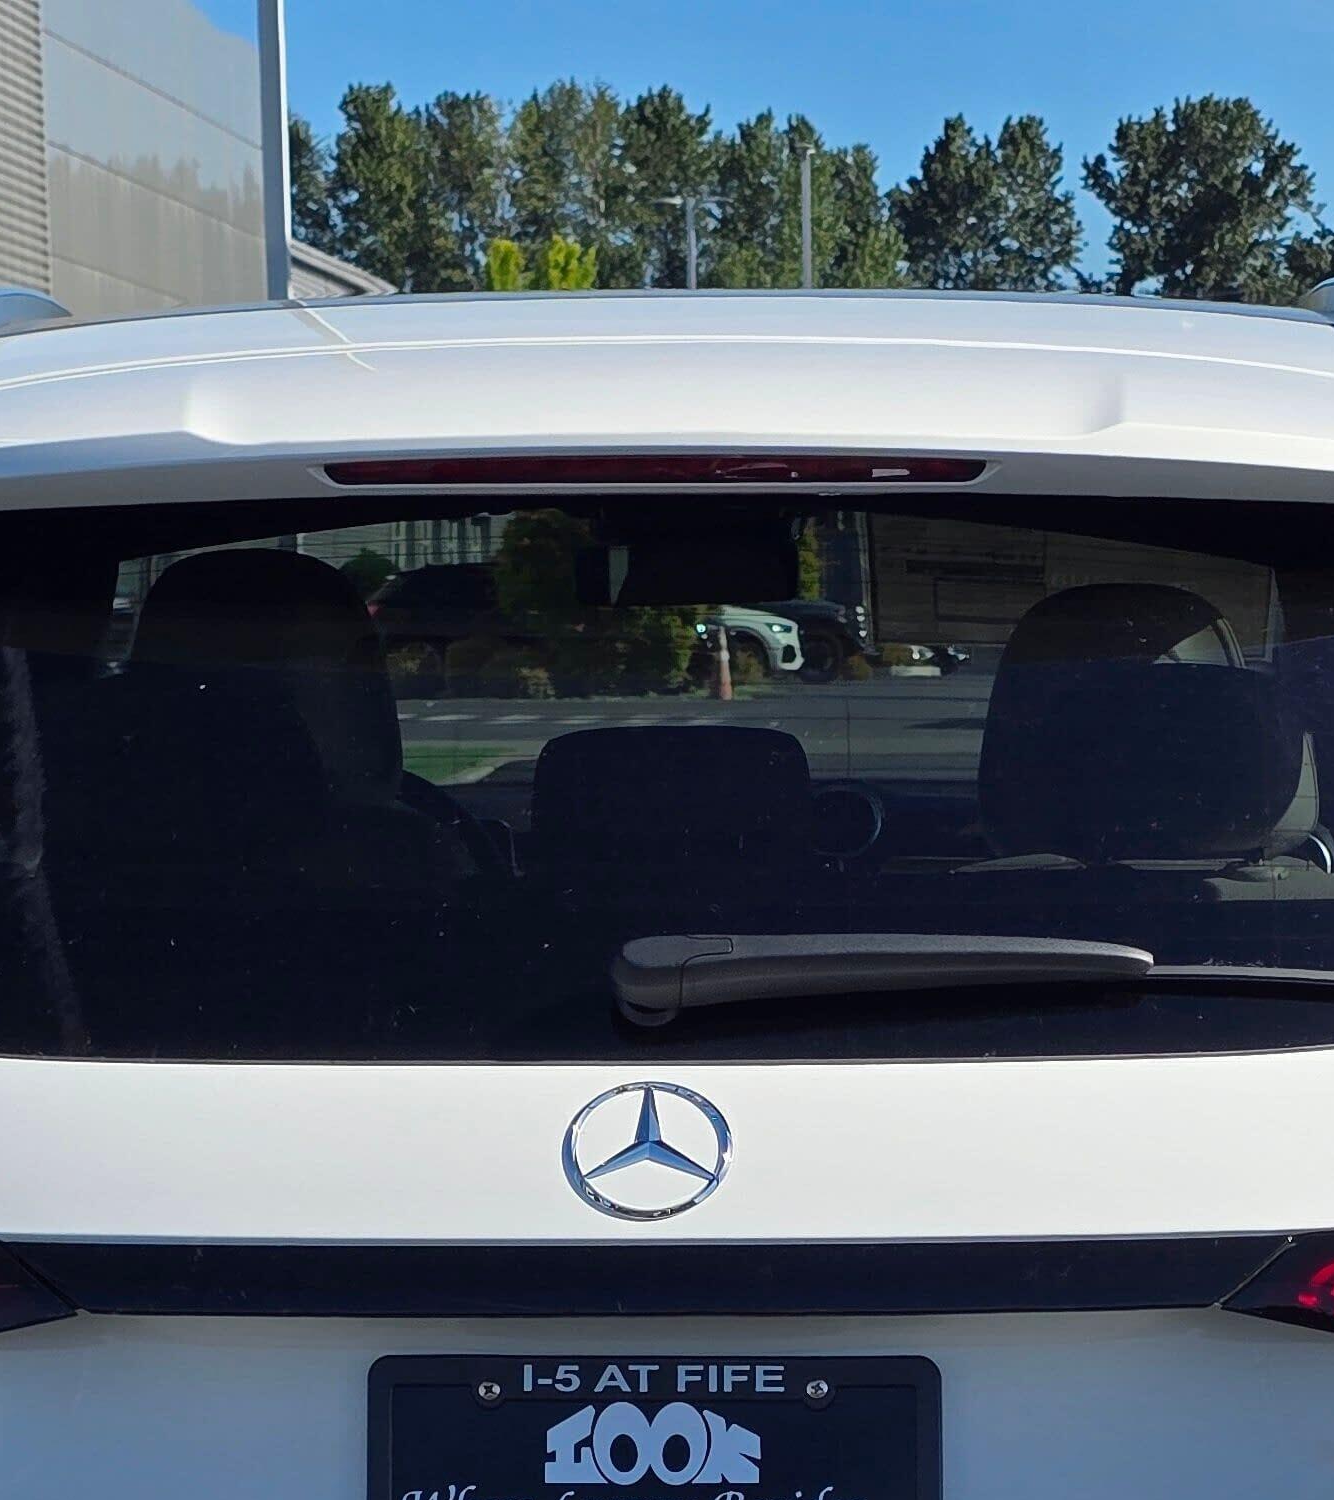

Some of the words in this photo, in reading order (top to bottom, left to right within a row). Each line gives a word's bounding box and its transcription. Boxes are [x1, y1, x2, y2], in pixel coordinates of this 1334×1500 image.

[524, 1365, 580, 1392] I-5
[594, 1365, 659, 1392] AT
[677, 1365, 784, 1392] FIFE
[545, 1402, 760, 1485] LOOK
